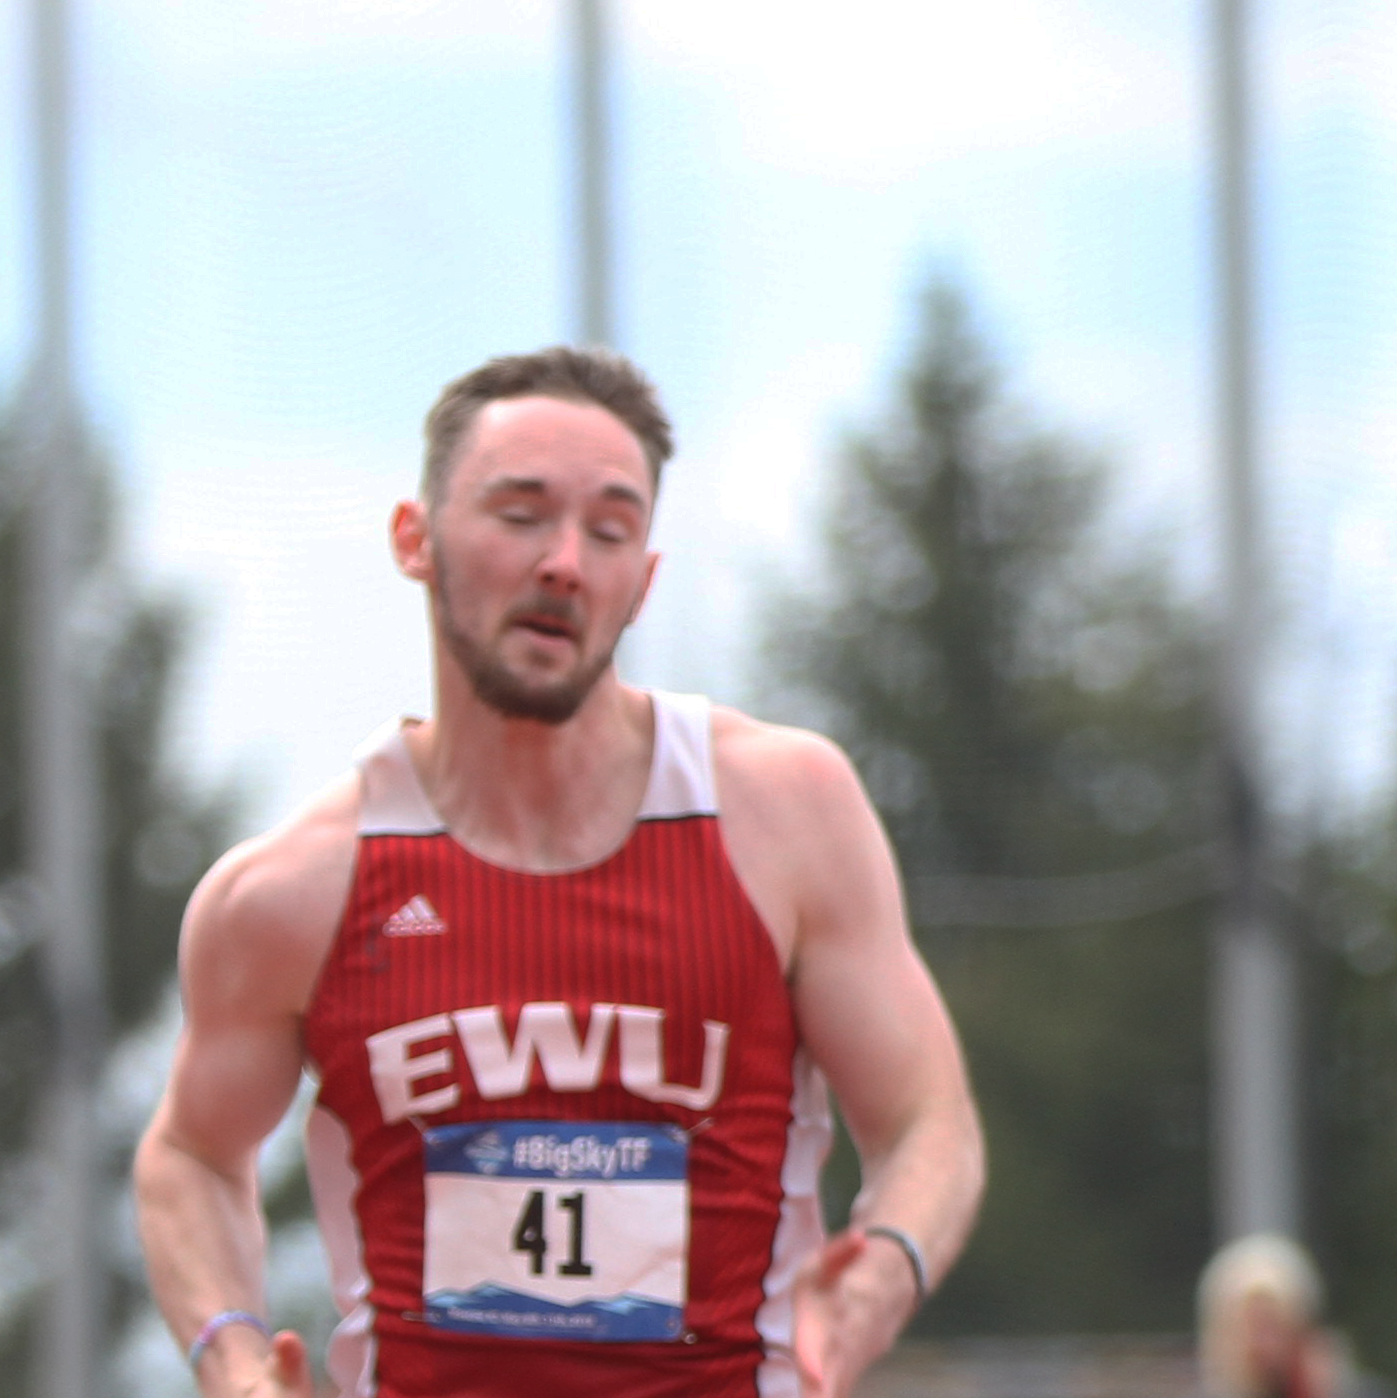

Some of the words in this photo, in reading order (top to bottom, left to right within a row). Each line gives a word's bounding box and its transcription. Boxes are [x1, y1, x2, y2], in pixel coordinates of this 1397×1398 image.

[365, 1001, 730, 1125] EWU
[512, 1134, 652, 1178] #BigSkyTF
[510, 1189, 592, 1277] 41
